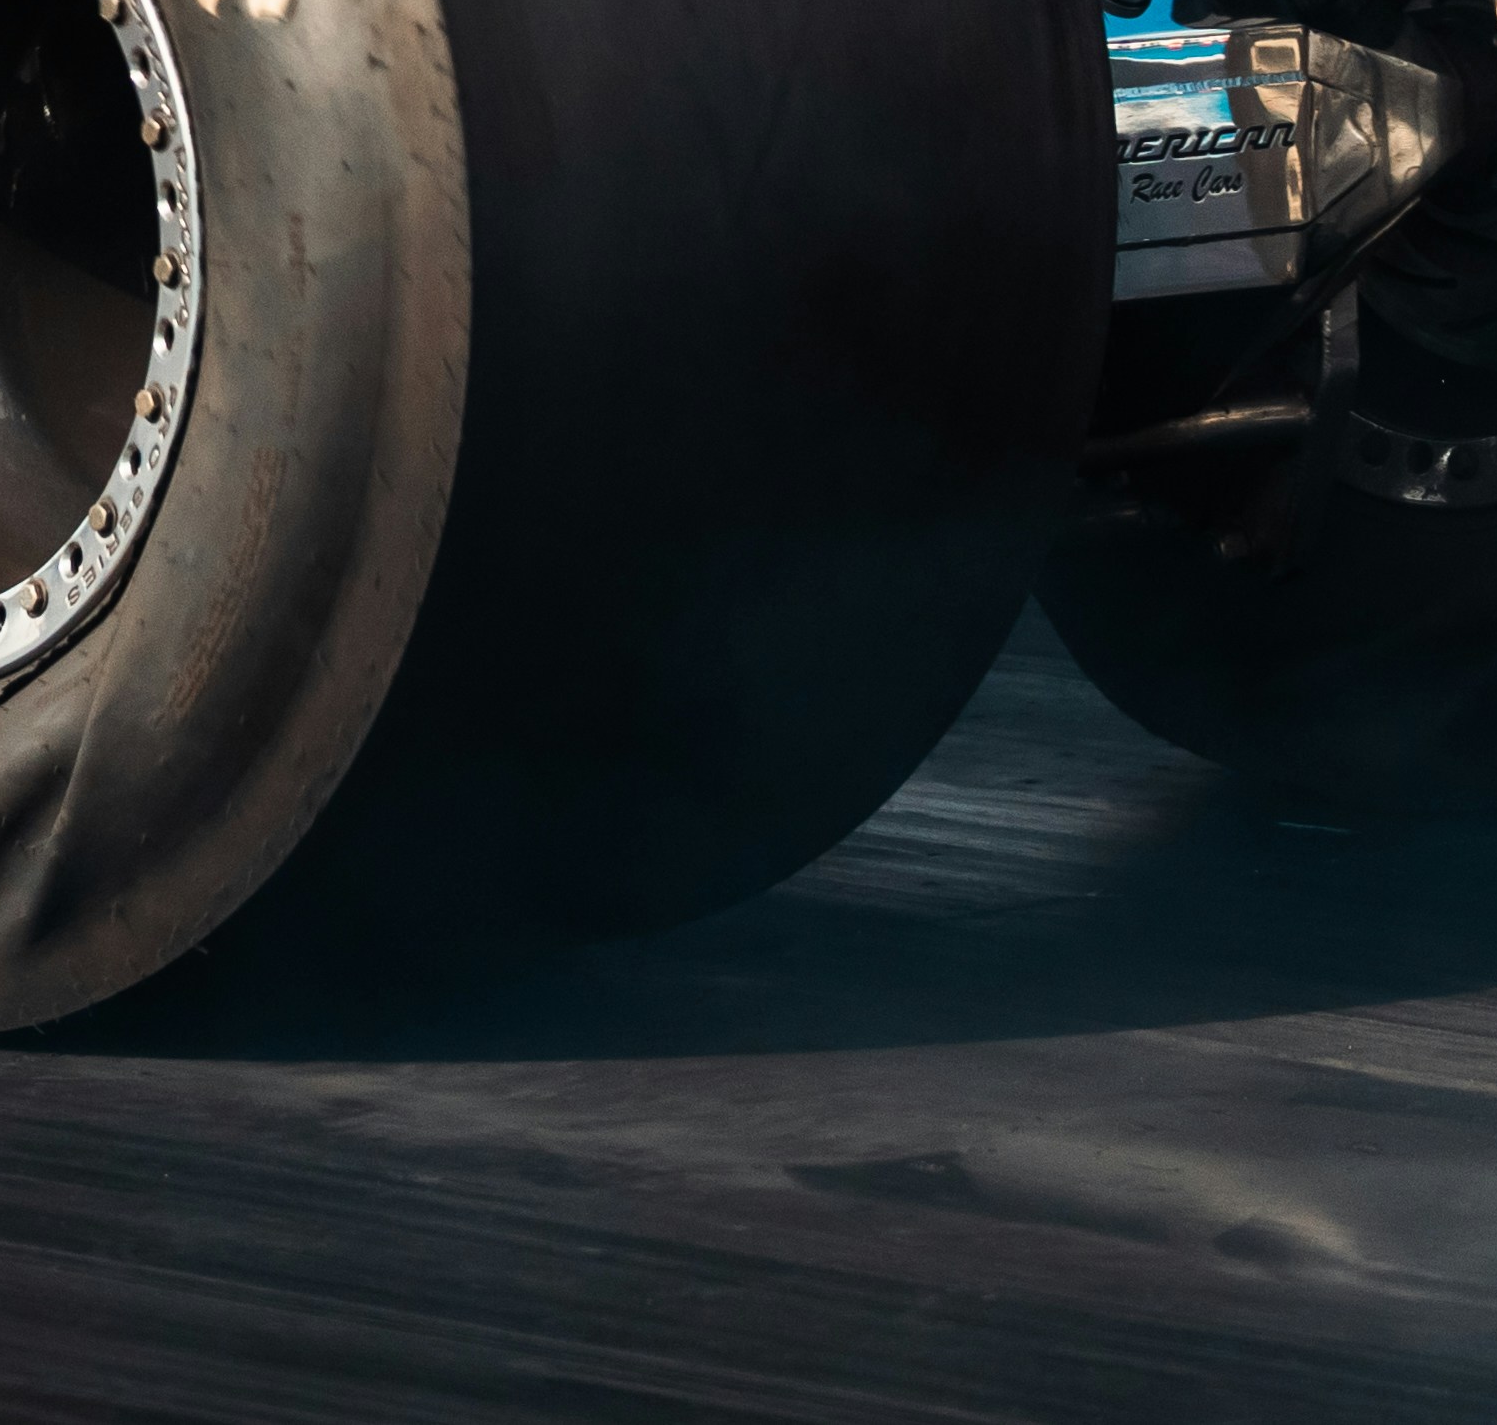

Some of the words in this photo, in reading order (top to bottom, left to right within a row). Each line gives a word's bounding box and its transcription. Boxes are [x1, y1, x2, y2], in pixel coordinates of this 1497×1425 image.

[1117, 122, 1295, 164] ERICAN
[1130, 173, 1184, 204] Race
[1192, 164, 1243, 202] Cars
